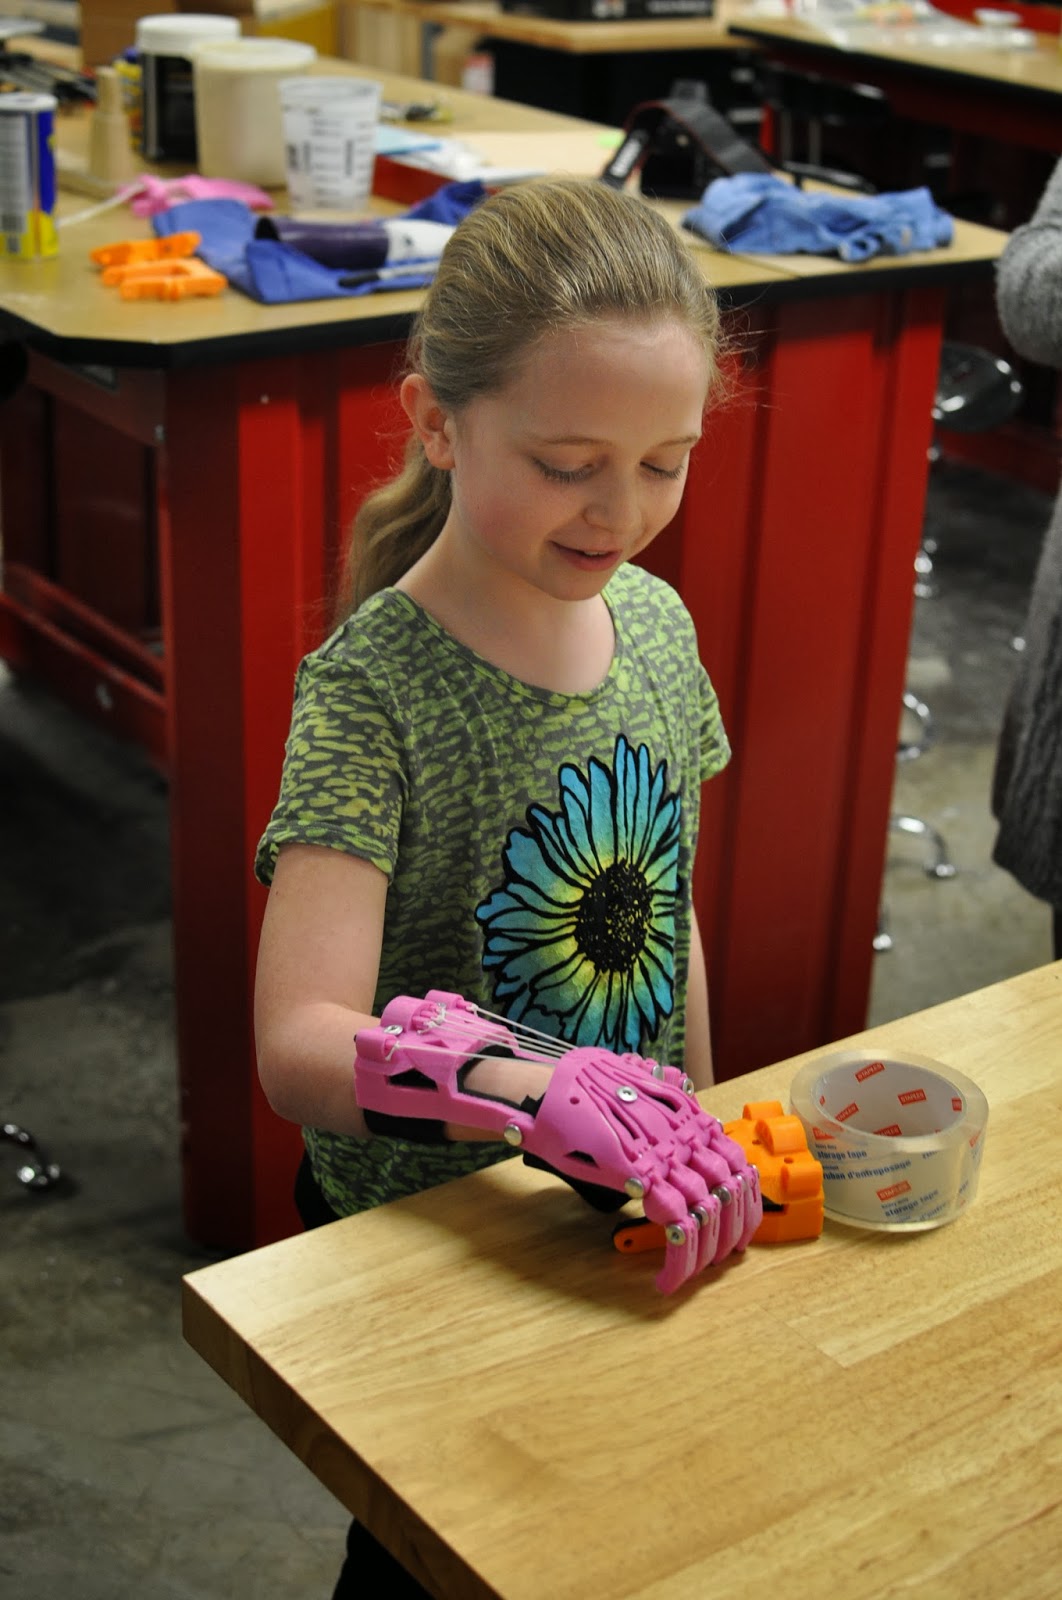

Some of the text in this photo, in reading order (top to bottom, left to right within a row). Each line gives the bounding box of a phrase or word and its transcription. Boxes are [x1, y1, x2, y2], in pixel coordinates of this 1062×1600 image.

[856, 1063, 883, 1081] STAPLES
[900, 1090, 925, 1104] STAPLES
[817, 1150, 867, 1161] storage tape
